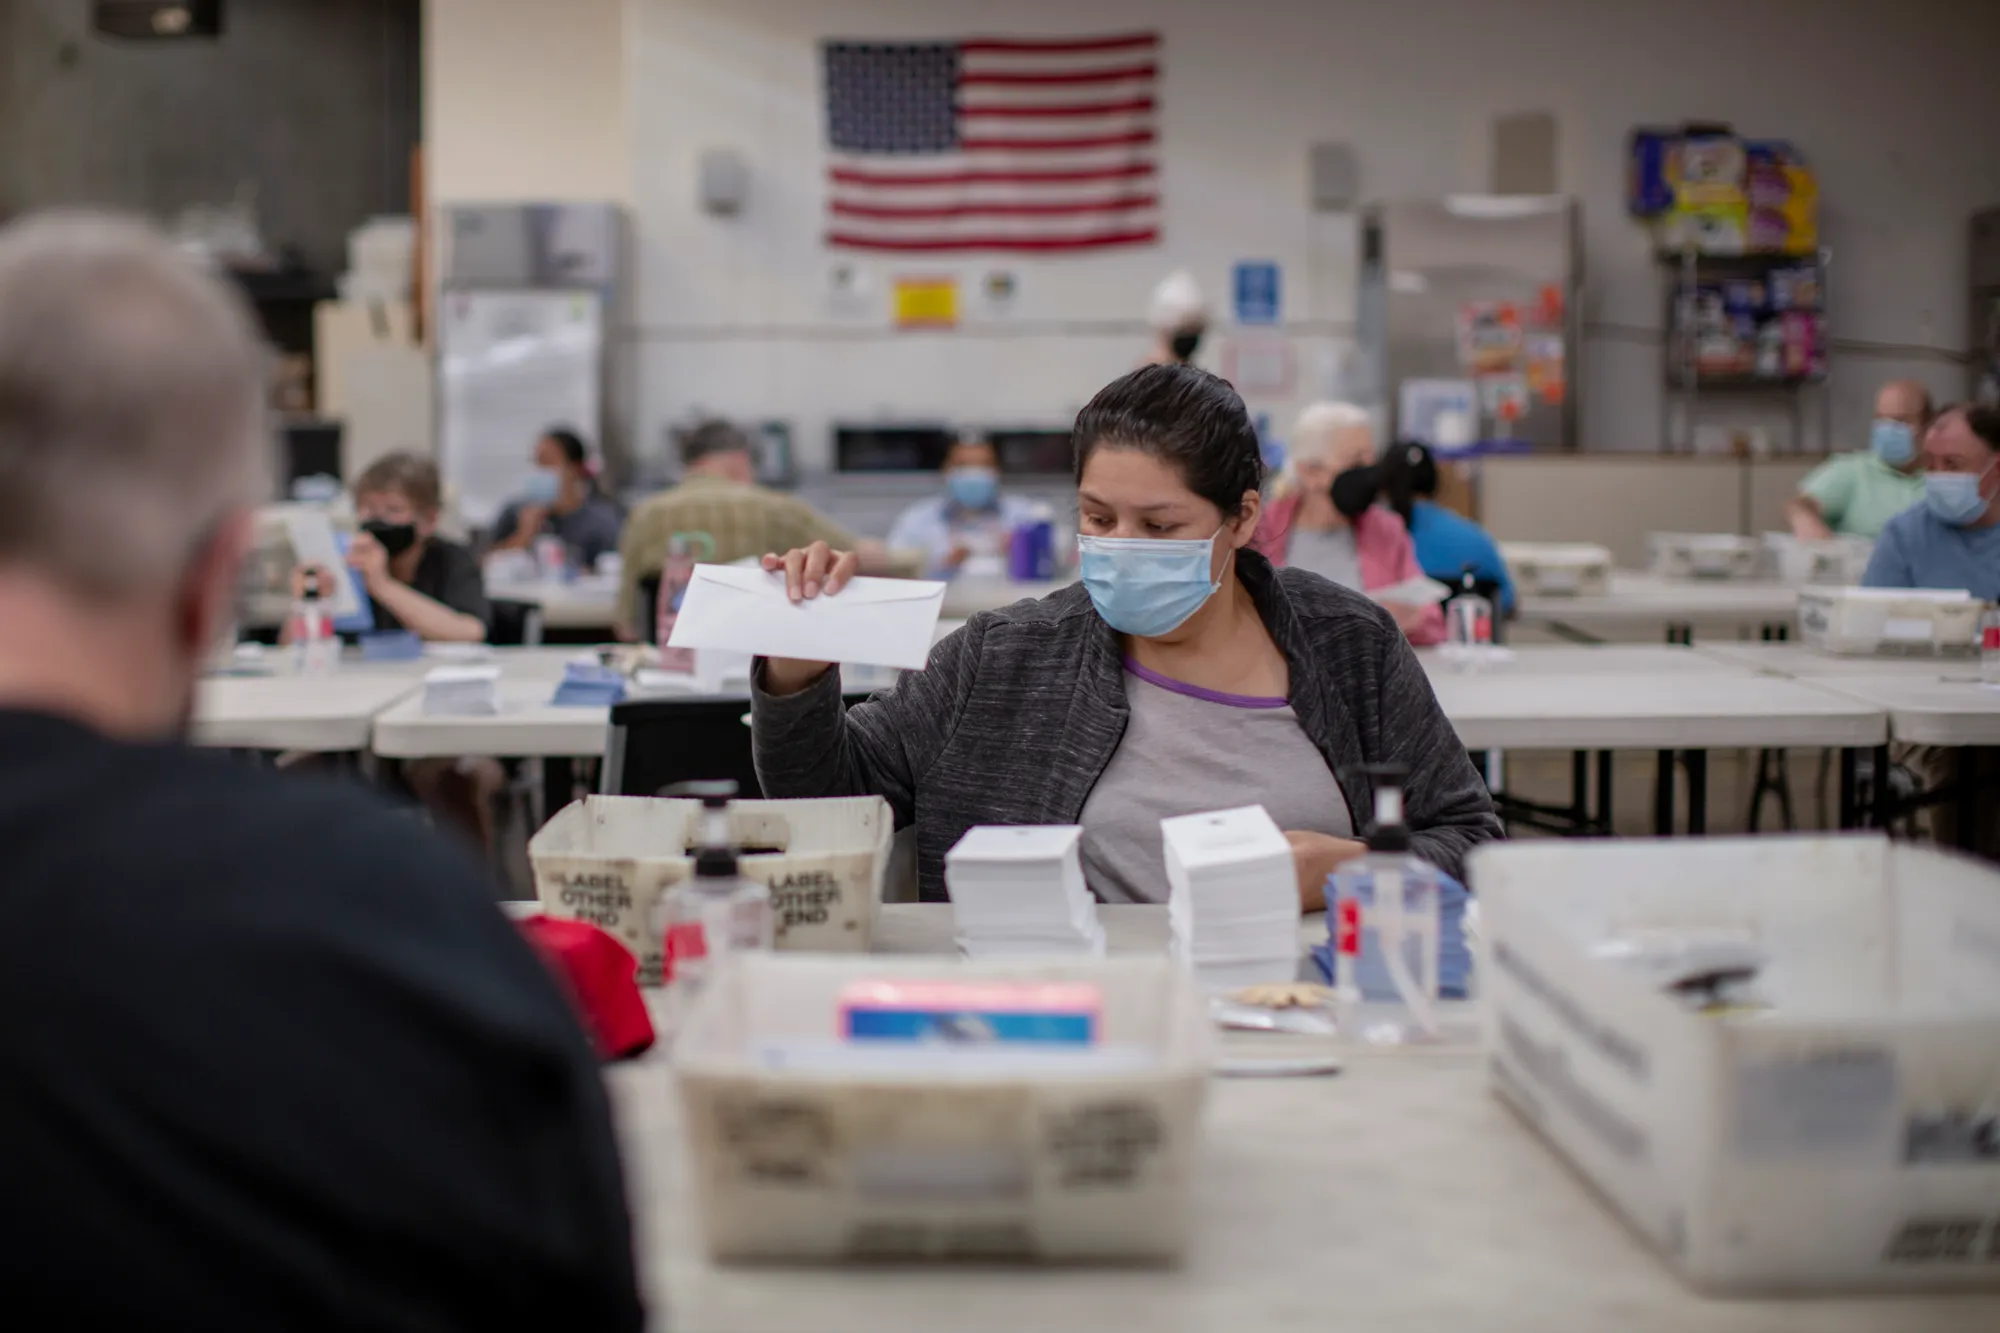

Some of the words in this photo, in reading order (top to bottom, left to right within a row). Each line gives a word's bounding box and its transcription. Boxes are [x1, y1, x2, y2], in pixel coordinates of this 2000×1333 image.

[768, 870, 839, 891] LABEL
[561, 890, 632, 911] OTHER
[783, 907, 829, 927] END
